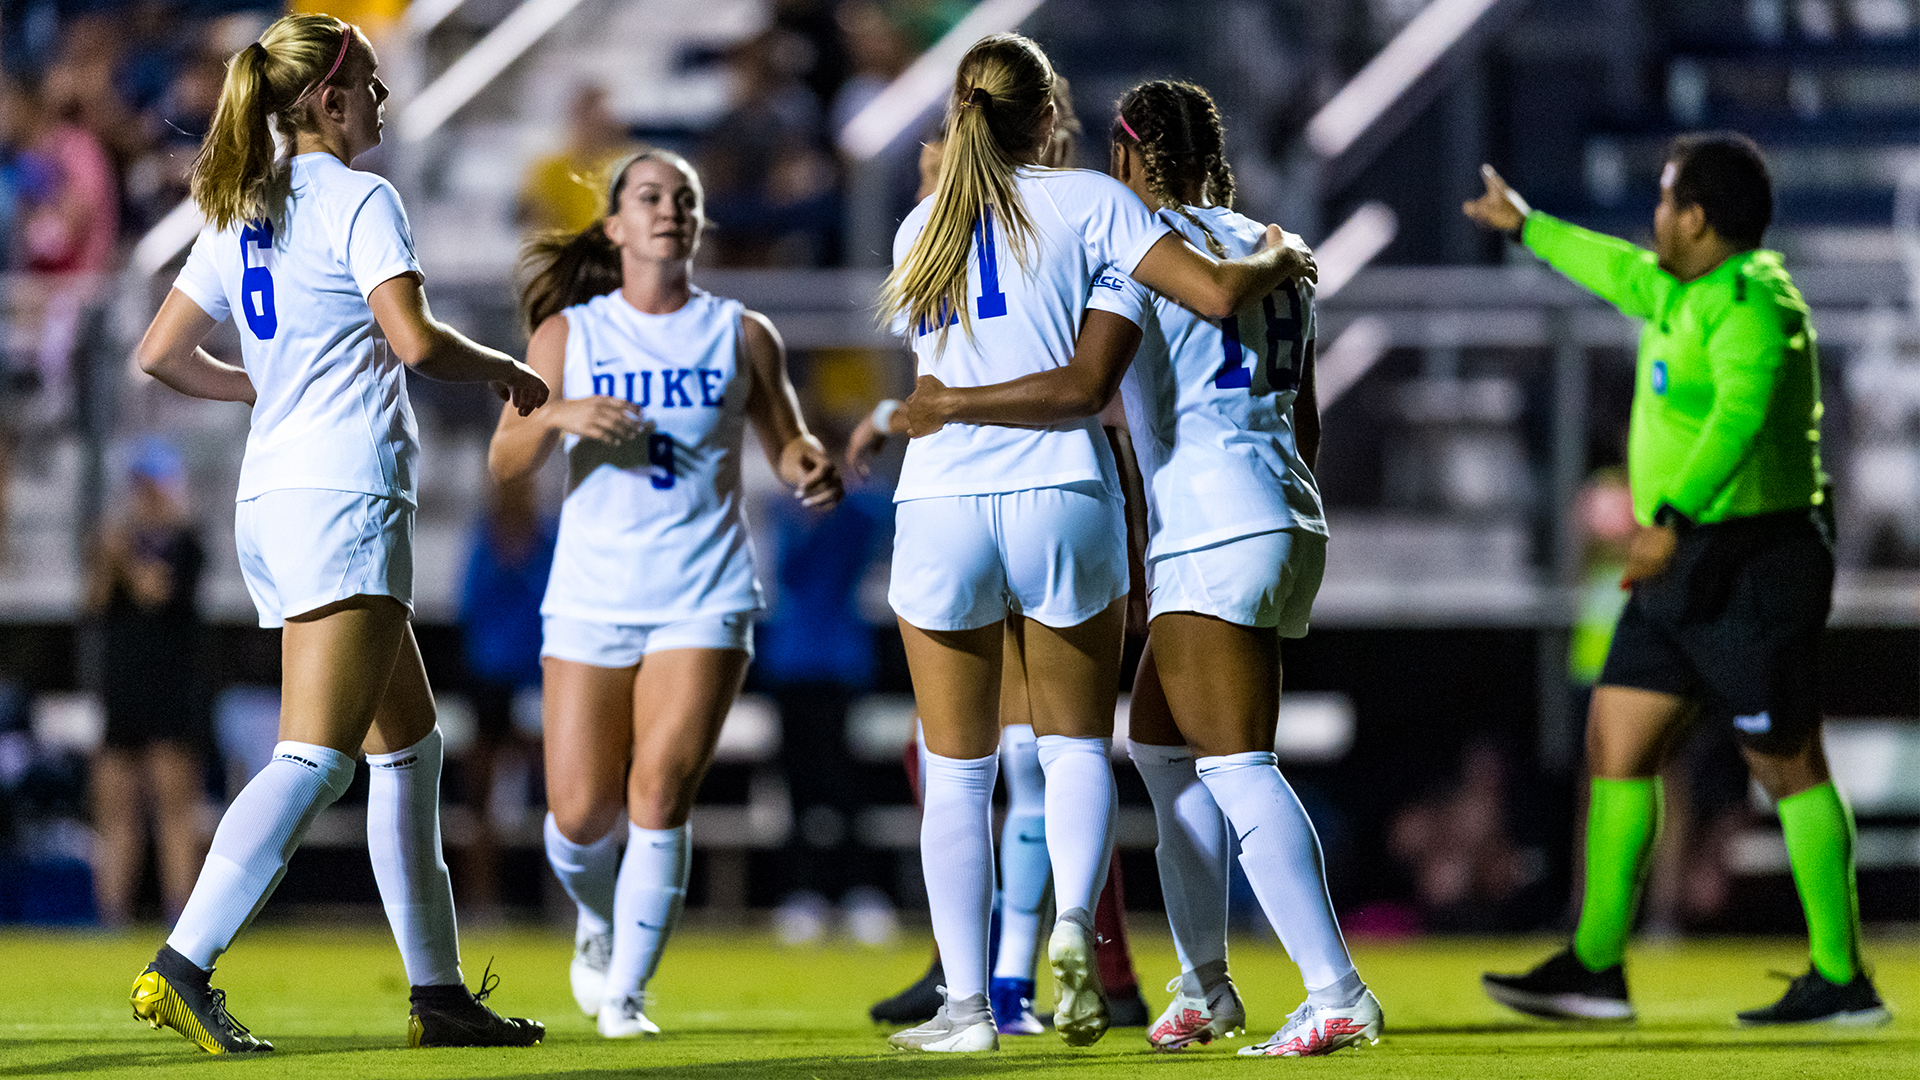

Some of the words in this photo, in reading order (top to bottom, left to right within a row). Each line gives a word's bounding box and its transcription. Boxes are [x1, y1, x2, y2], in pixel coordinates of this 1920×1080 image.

[240, 216, 278, 340] 6
[1214, 275, 1303, 390] 18
[592, 368, 724, 408] DUKE
[649, 431, 676, 489] 9
[282, 753, 318, 768] GRIP
